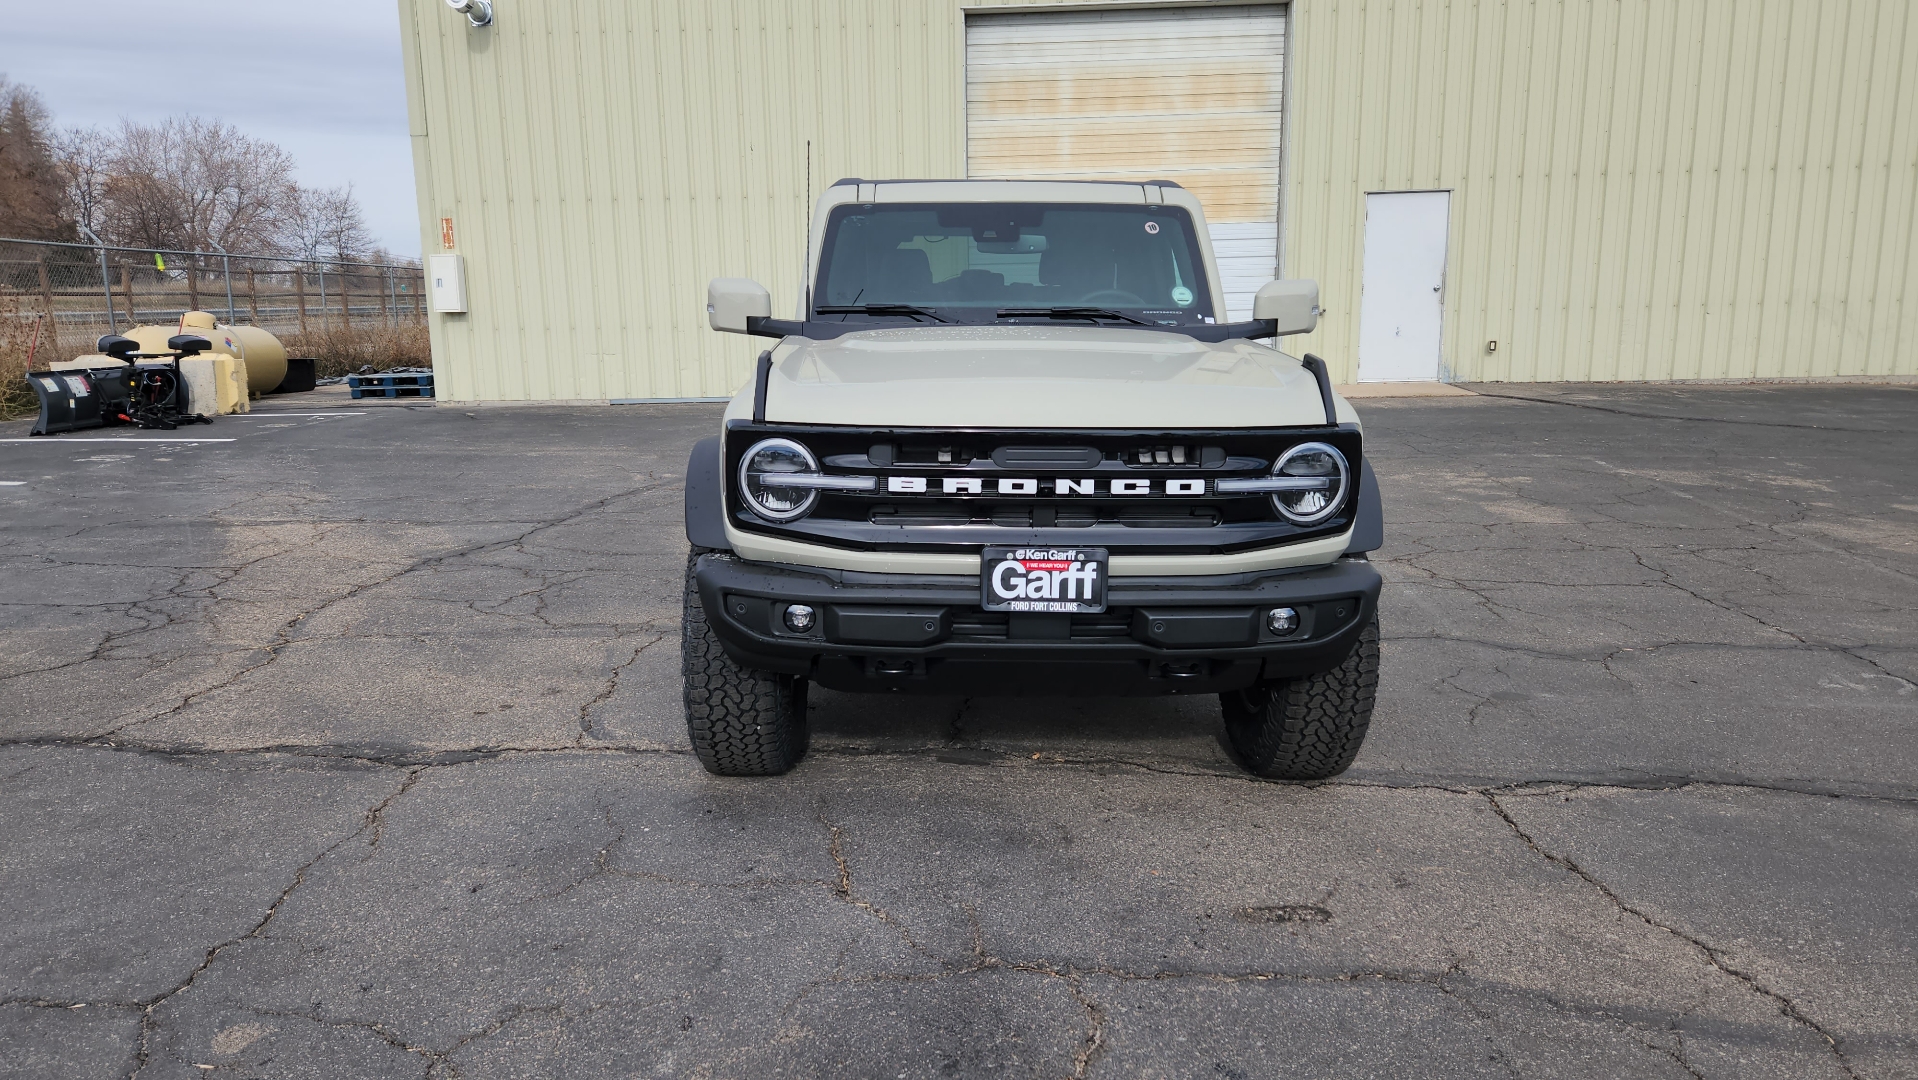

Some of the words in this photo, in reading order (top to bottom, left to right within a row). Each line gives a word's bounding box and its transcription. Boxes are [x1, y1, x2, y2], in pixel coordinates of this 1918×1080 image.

[887, 476, 1206, 495] BRONCO
[1025, 550, 1048, 560] Ken
[1049, 550, 1076, 560] Garff
[992, 560, 1097, 599] Garff
[1011, 601, 1029, 611] FORD
[1031, 601, 1047, 611] FORT
[1050, 602, 1078, 611] COLLINS
